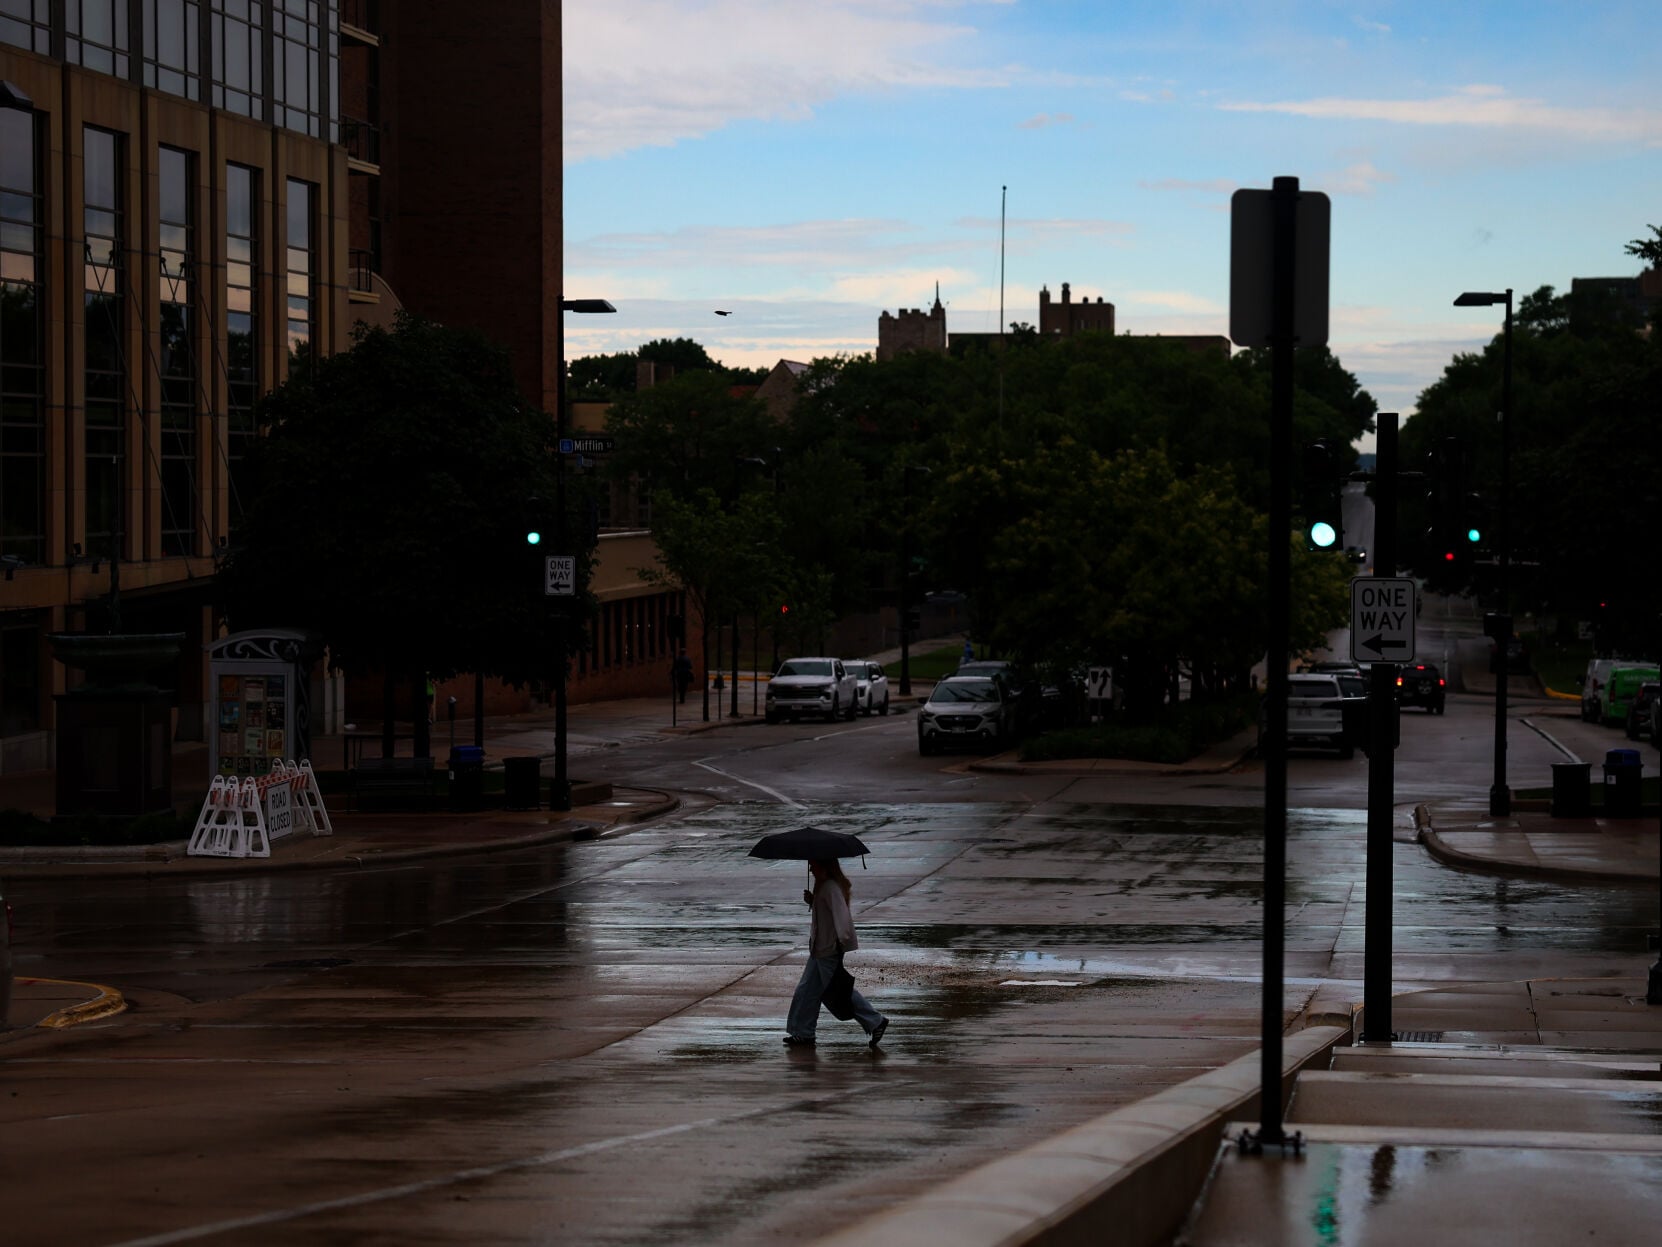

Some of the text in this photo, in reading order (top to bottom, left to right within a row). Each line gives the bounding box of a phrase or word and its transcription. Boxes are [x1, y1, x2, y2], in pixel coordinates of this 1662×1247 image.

[574, 439, 604, 452] Mifflin
[550, 560, 570, 570] ONE
[549, 571, 571, 581] WAY
[1361, 588, 1406, 607] ONE
[1360, 611, 1407, 630] WAY
[271, 791, 287, 810] ROAD
[270, 811, 291, 833] CLOSED
